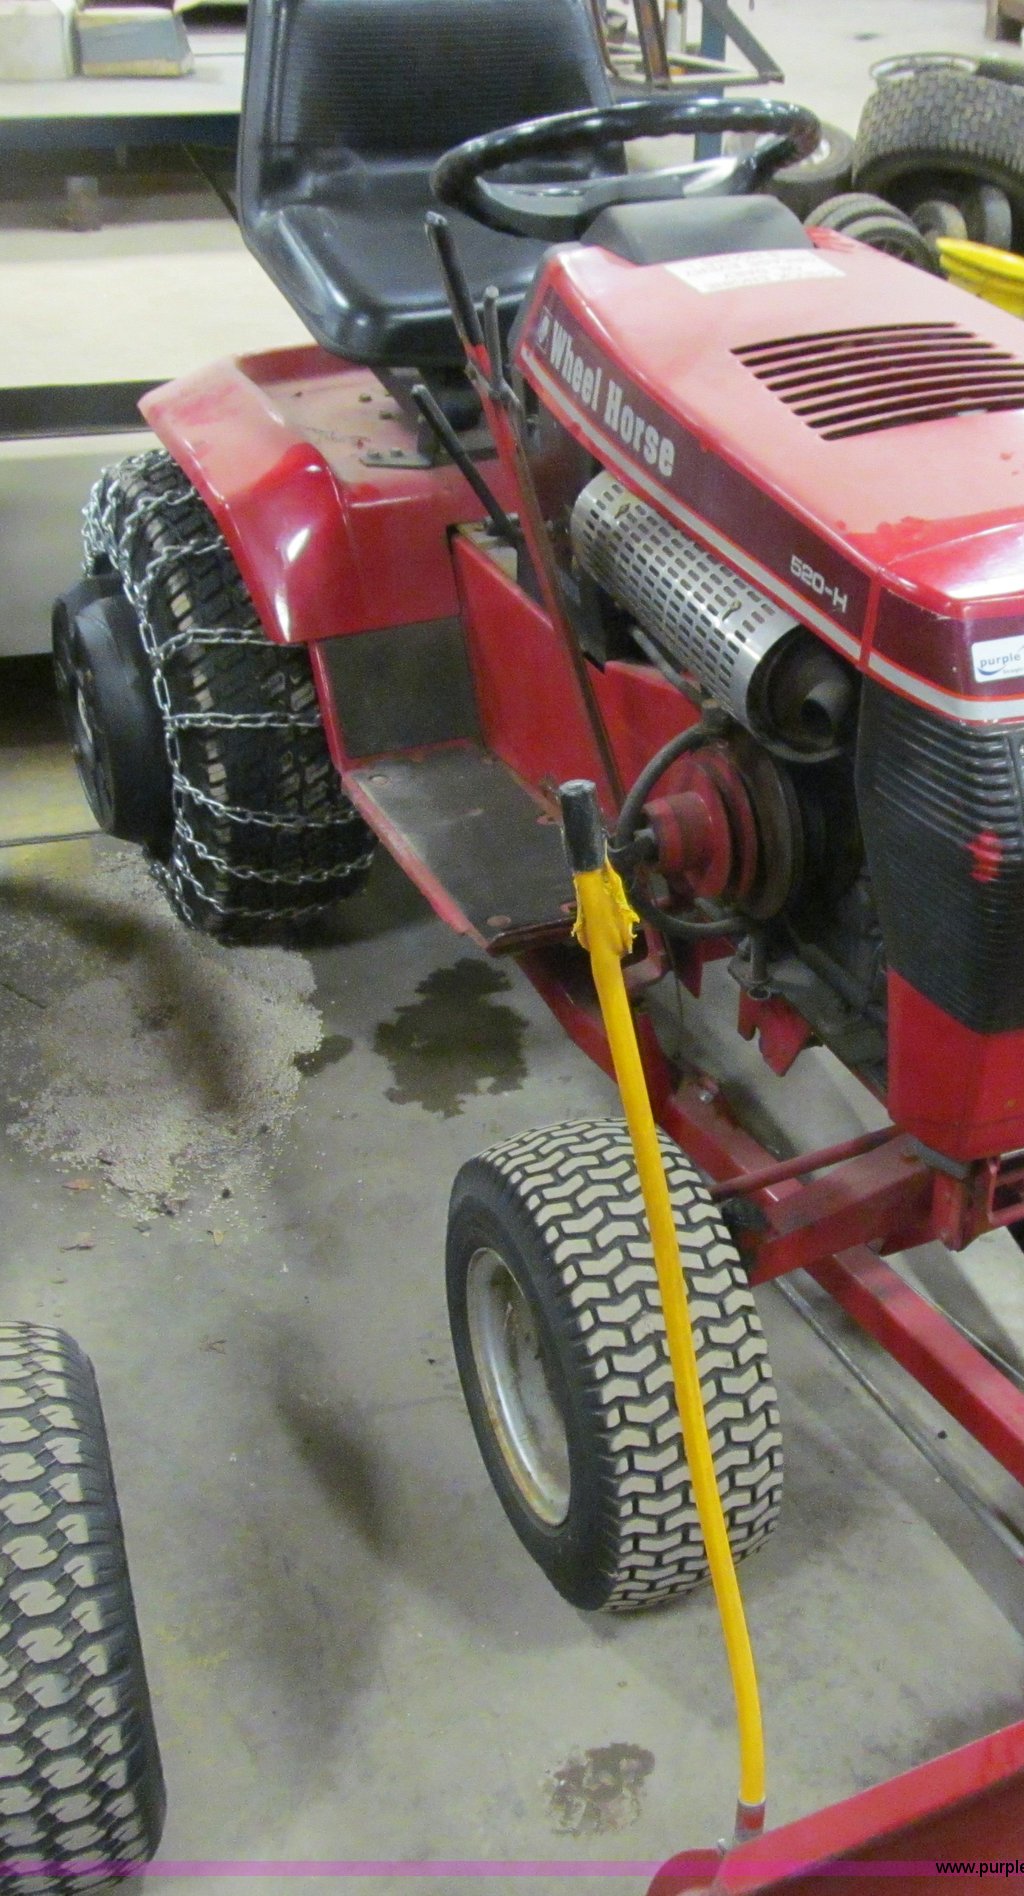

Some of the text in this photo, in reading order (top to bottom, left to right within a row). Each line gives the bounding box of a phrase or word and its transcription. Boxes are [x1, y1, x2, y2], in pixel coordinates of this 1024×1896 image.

[551, 320, 676, 477] Wheel Horse
[790, 554, 848, 613] 520-H
[980, 652, 1021, 668] purple
